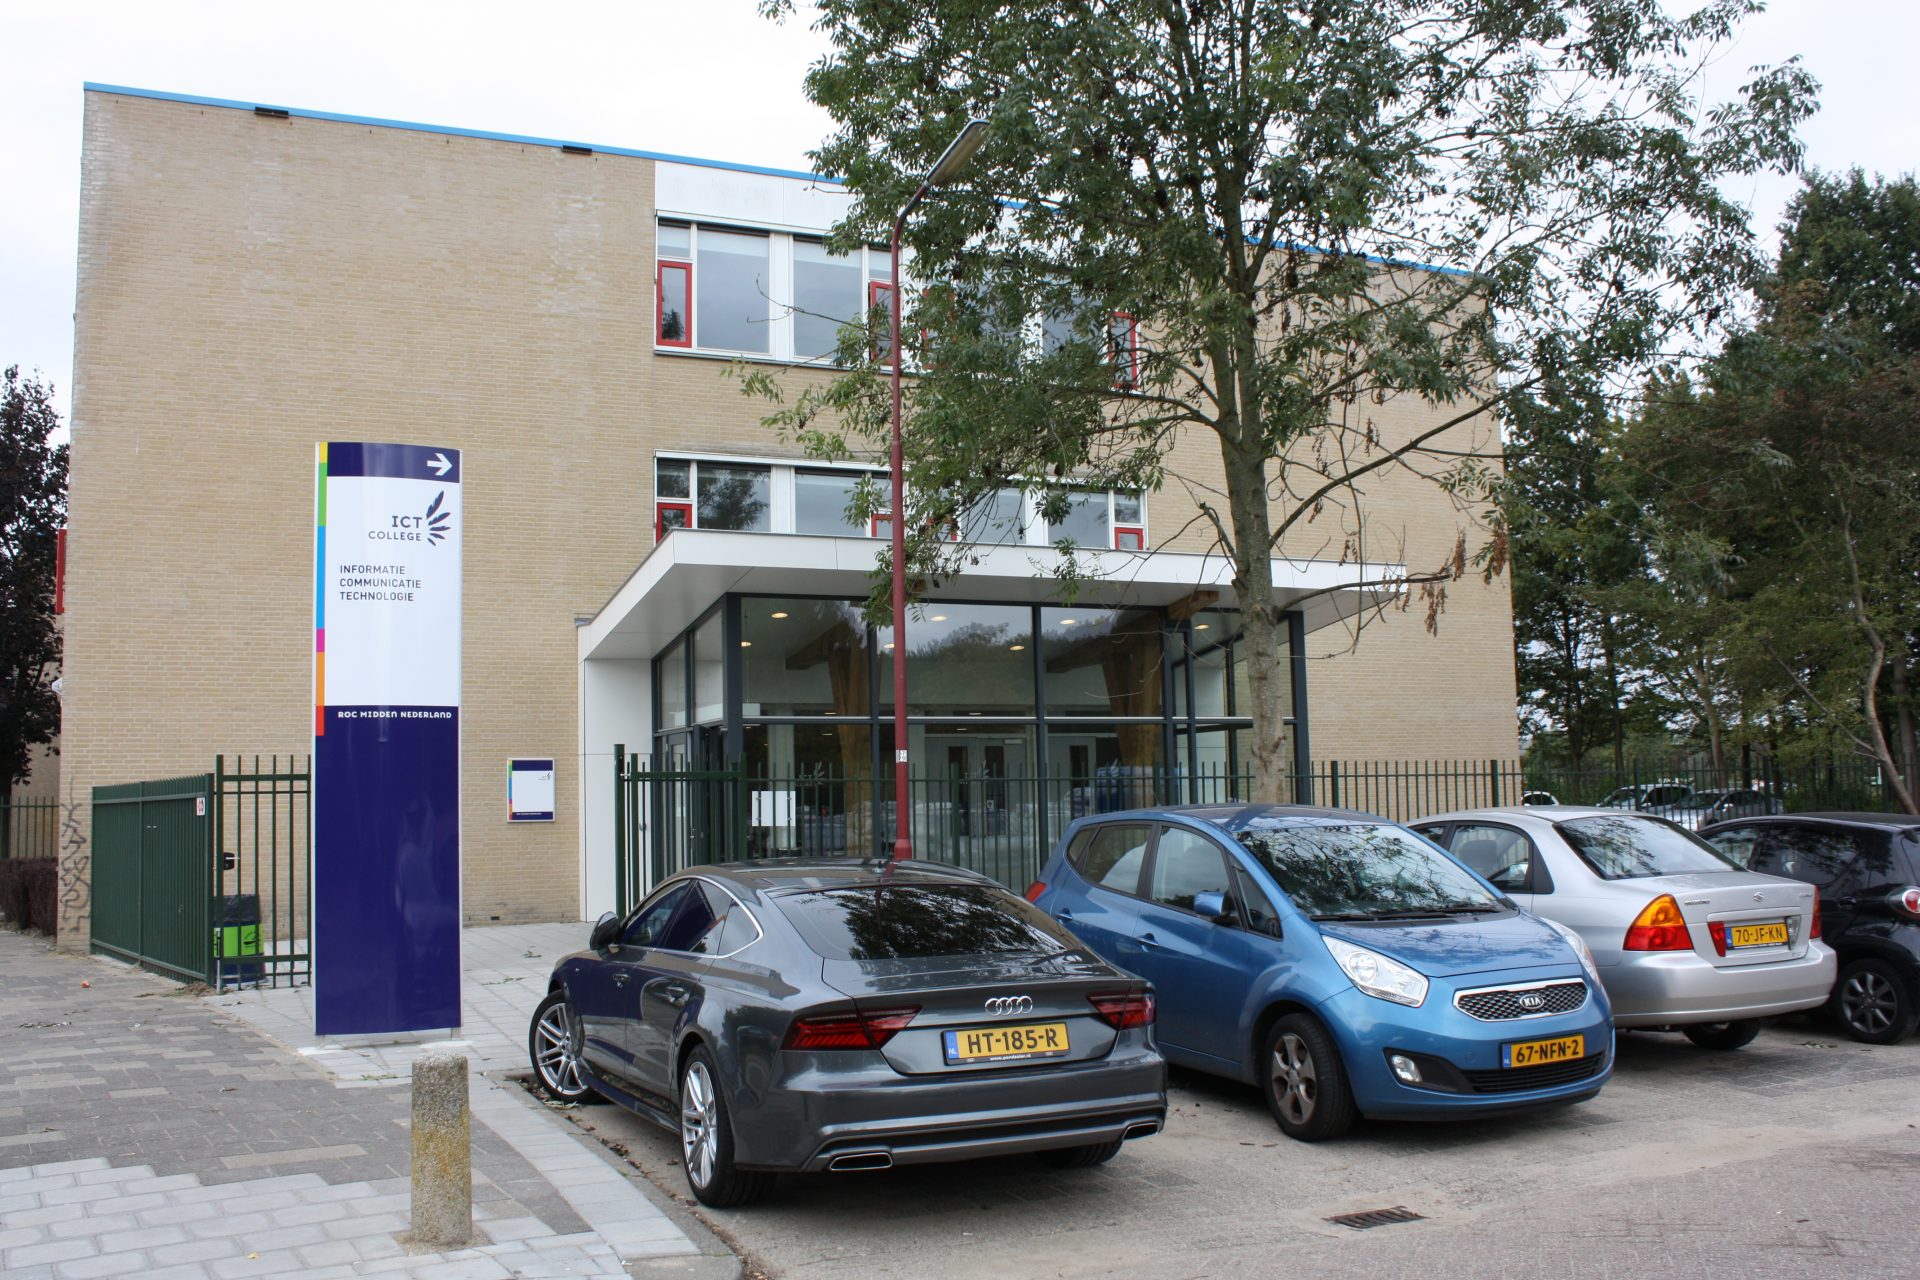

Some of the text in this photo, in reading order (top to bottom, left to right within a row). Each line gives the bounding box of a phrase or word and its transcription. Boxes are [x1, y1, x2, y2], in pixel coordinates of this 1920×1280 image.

[391, 515, 423, 529] ICT
[368, 531, 422, 541] COLLEGE
[340, 565, 406, 575] INFORMATIE
[339, 578, 422, 589] COMMUNICATIE
[340, 591, 414, 602] TECHNOLOGIE
[338, 711, 358, 719] ROC
[400, 711, 452, 719] NEDERLAND
[1735, 926, 1783, 944] 70-JF-KN
[1524, 997, 1541, 1006] KIA
[967, 1028, 1059, 1054] HT-185-R
[1516, 1039, 1579, 1063] 67-NFN-2
